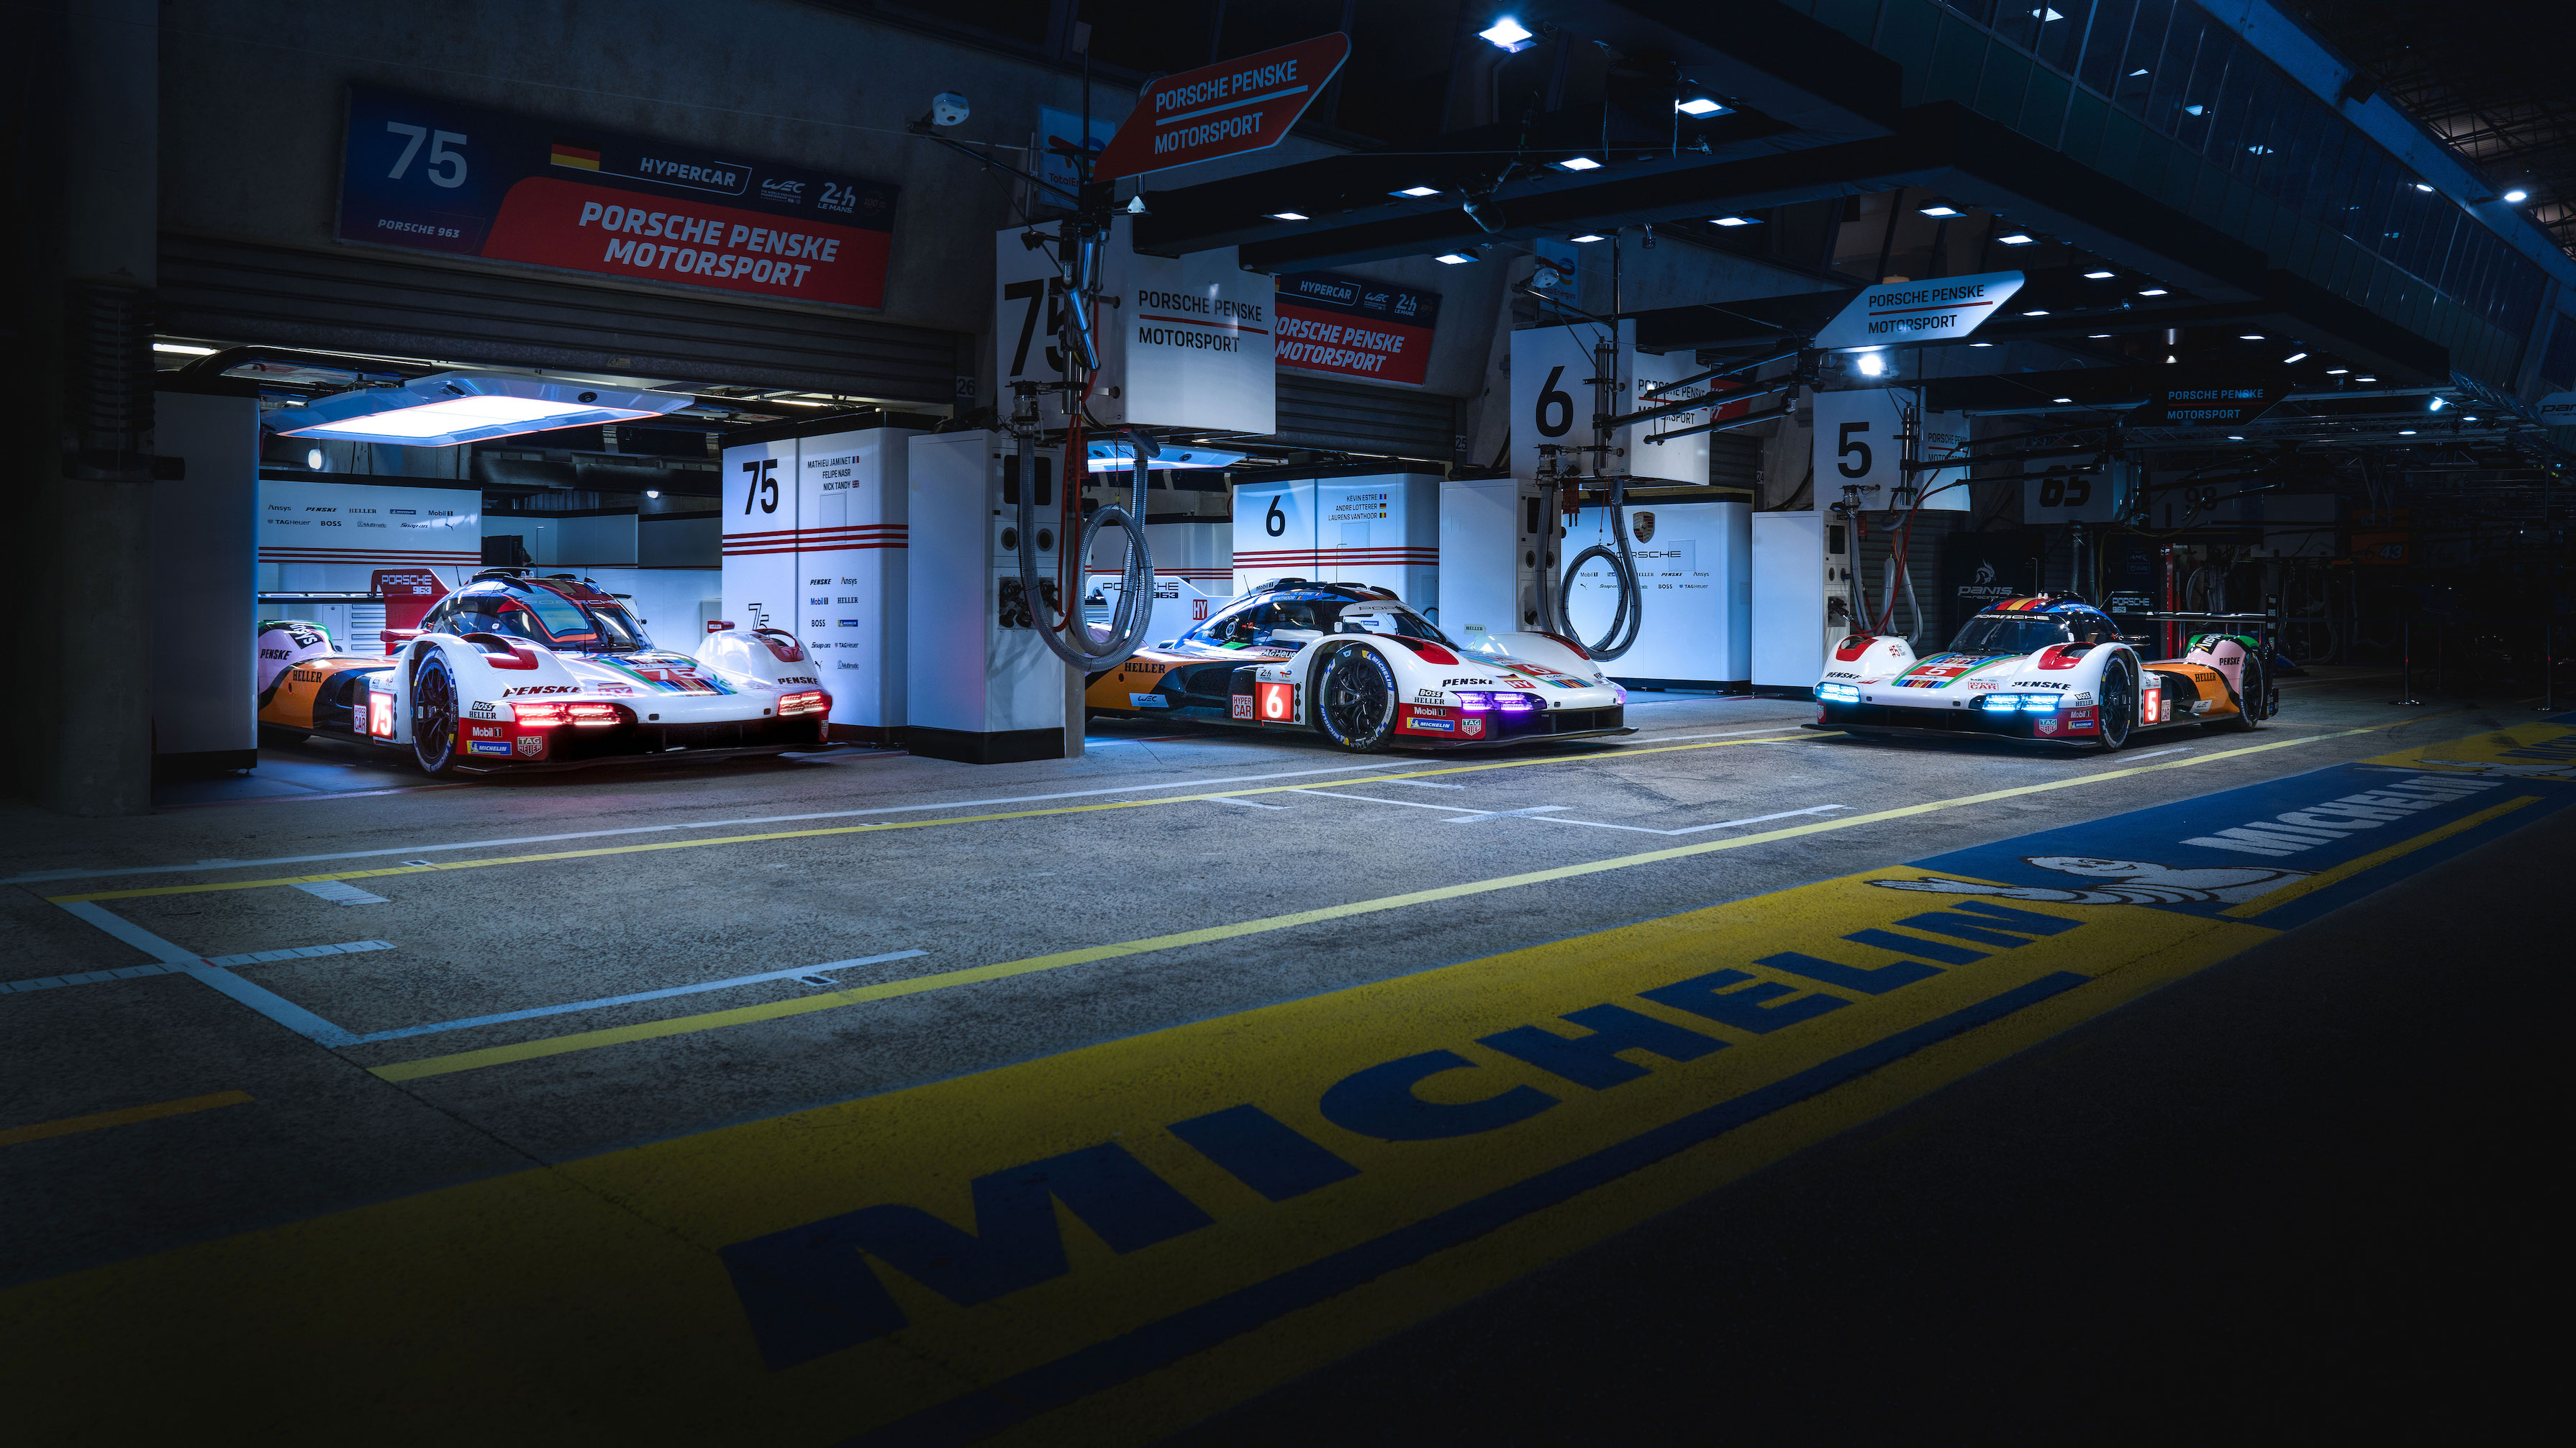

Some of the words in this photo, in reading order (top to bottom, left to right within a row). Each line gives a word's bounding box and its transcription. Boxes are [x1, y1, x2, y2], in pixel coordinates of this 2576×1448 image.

[1156, 74, 1229, 113] PORSCHE
[1232, 59, 1297, 95] PENSKE
[1154, 112, 1264, 155] MOTORSPORT
[386, 120, 468, 190] 75
[640, 157, 736, 187] HYPERCAR
[830, 204, 853, 214] MANS
[378, 219, 435, 236] PORSCHE
[437, 227, 461, 239] 963
[579, 201, 722, 245] PORSCHE
[728, 223, 841, 263] PENSKE
[603, 237, 812, 288] MOTORSPORT
[1300, 281, 1352, 300] HYPERCAR
[1869, 290, 1929, 308] PORSCHE
[1932, 284, 1985, 301] PENSKE
[1140, 290, 1210, 314] PORSCHE
[1214, 299, 1263, 323] PENSKE
[1868, 314, 1957, 334] MOTORSPORT
[1140, 327, 1240, 353] MOTORSPORT
[1342, 326, 1405, 353] PENSKE
[1275, 340, 1387, 373] MOTORSPORT
[956, 377, 975, 396] 26
[1535, 365, 1574, 437] 6
[2168, 390, 2218, 401] PORSCHE
[2221, 388, 2264, 399] PENSKE
[2167, 409, 2241, 420] MOTORSPORT
[1456, 437, 1467, 451] 25
[1928, 432, 1954, 445] PORSCHE
[1837, 422, 1872, 478] 5
[807, 459, 829, 469] MATHIEU
[830, 456, 851, 467] JAMINET
[822, 470, 838, 479] FELIPE
[838, 468, 851, 477] NASR
[743, 458, 779, 515] 75
[823, 482, 835, 491] NICK
[835, 481, 851, 490] TANDY
[2039, 465, 2092, 508] 65
[1266, 495, 1285, 537] 6
[381, 575, 432, 586] PORSCHE
[840, 576, 858, 586] Ansys
[412, 586, 432, 595] 963
[2112, 597, 2150, 606] PORSCHE
[1193, 600, 1207, 620] HY
[260, 649, 292, 660] PENSKE
[1125, 662, 1166, 674] HELLER
[2219, 657, 2241, 666] PENSKE
[638, 668, 704, 680] 75
[1372, 655, 1392, 688] MICHELIN
[1526, 665, 1551, 674] 6
[1925, 667, 1951, 675] 5
[293, 670, 322, 683] HELLER
[1442, 678, 1495, 687] PENSKE
[2195, 673, 2216, 682] HELLER
[502, 686, 581, 698] PENSKE
[2012, 681, 2072, 691] PENSKE
[473, 702, 494, 711] BOSS
[1266, 686, 1283, 718] 6
[2148, 691, 2157, 721] 5
[371, 693, 392, 736] 75
[1234, 705, 1251, 717] CAR
[1414, 706, 1437, 716] Mobil
[2162, 709, 2170, 719] CAR
[355, 716, 366, 732] CAR
[1463, 726, 1481, 734] HEUER
[472, 727, 493, 737] Mobil
[494, 727, 502, 737] 1
[519, 745, 540, 755] HEUER
[2178, 775, 2505, 857] MICHELIN
[722, 898, 2082, 1372] MICHELIN
